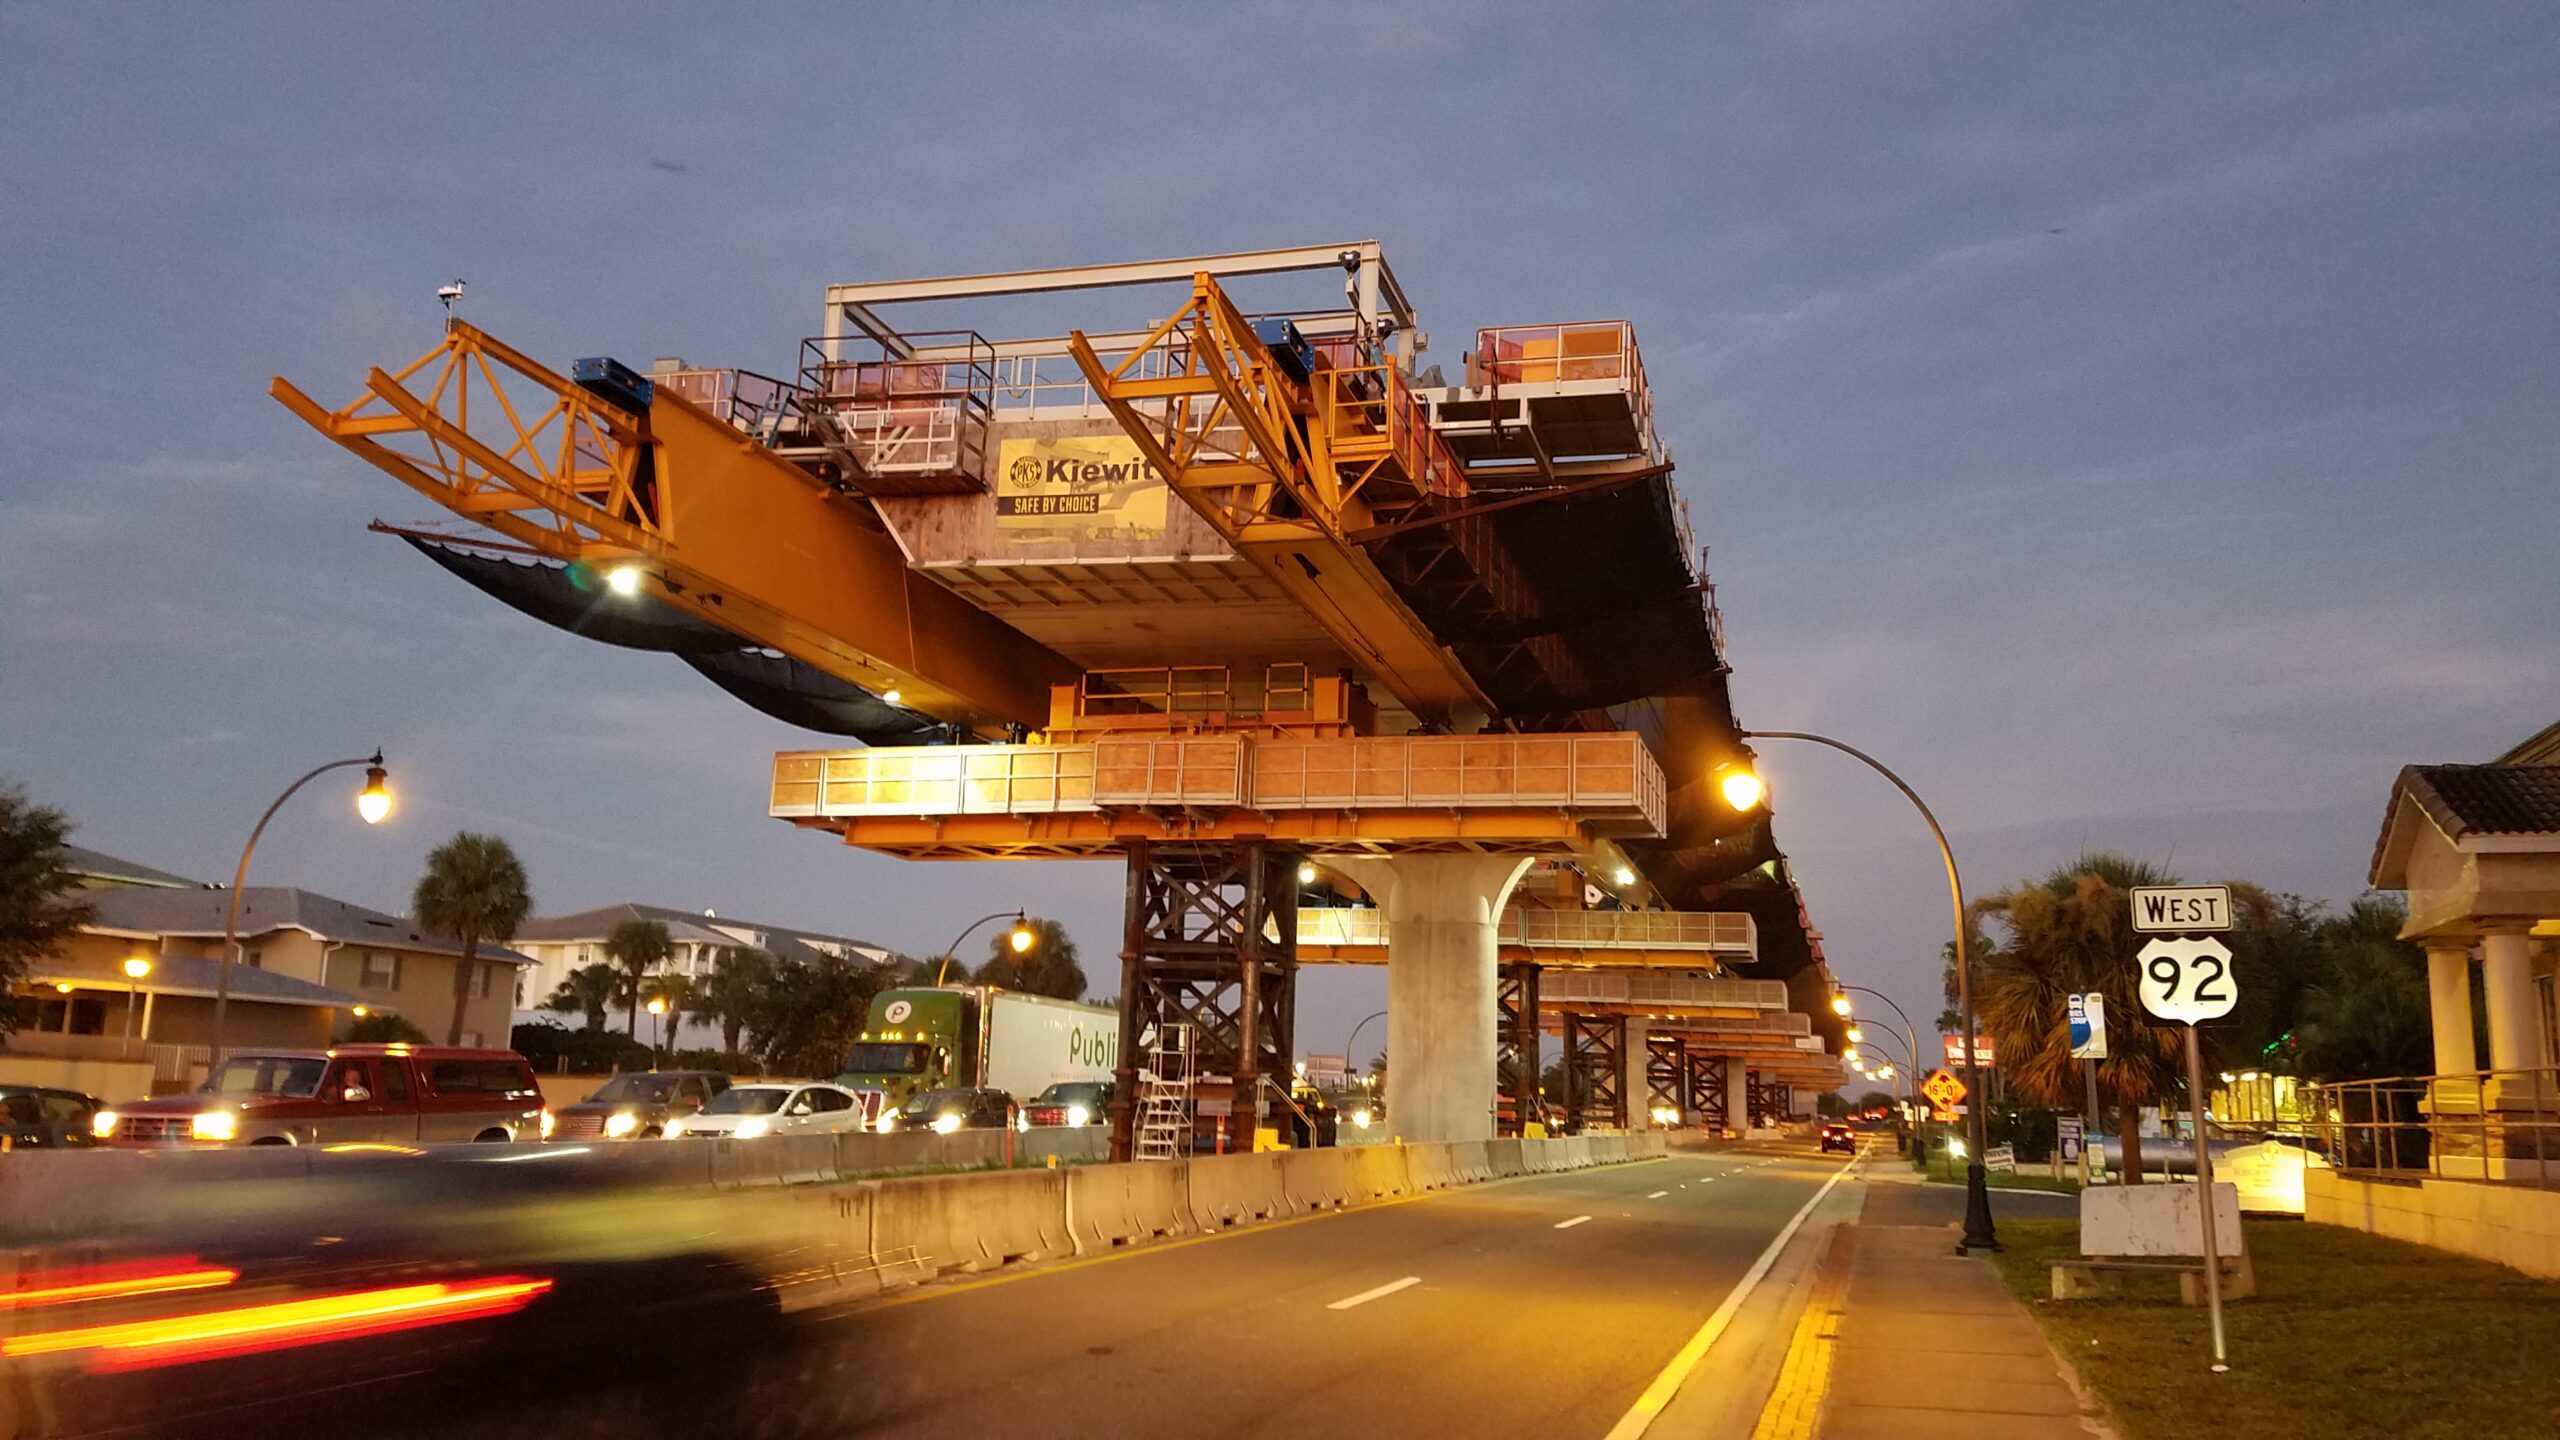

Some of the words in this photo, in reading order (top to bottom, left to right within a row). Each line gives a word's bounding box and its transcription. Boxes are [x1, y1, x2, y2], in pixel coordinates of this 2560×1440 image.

[1046, 457, 1154, 483] Kiewit
[1015, 497, 1039, 514] SAFE
[1042, 496, 1056, 513] BY
[1059, 495, 1096, 512] CHOICE
[2144, 896, 2218, 922] WEST
[2148, 955, 2227, 1002] 92
[1069, 1026, 1116, 1068] Publi
